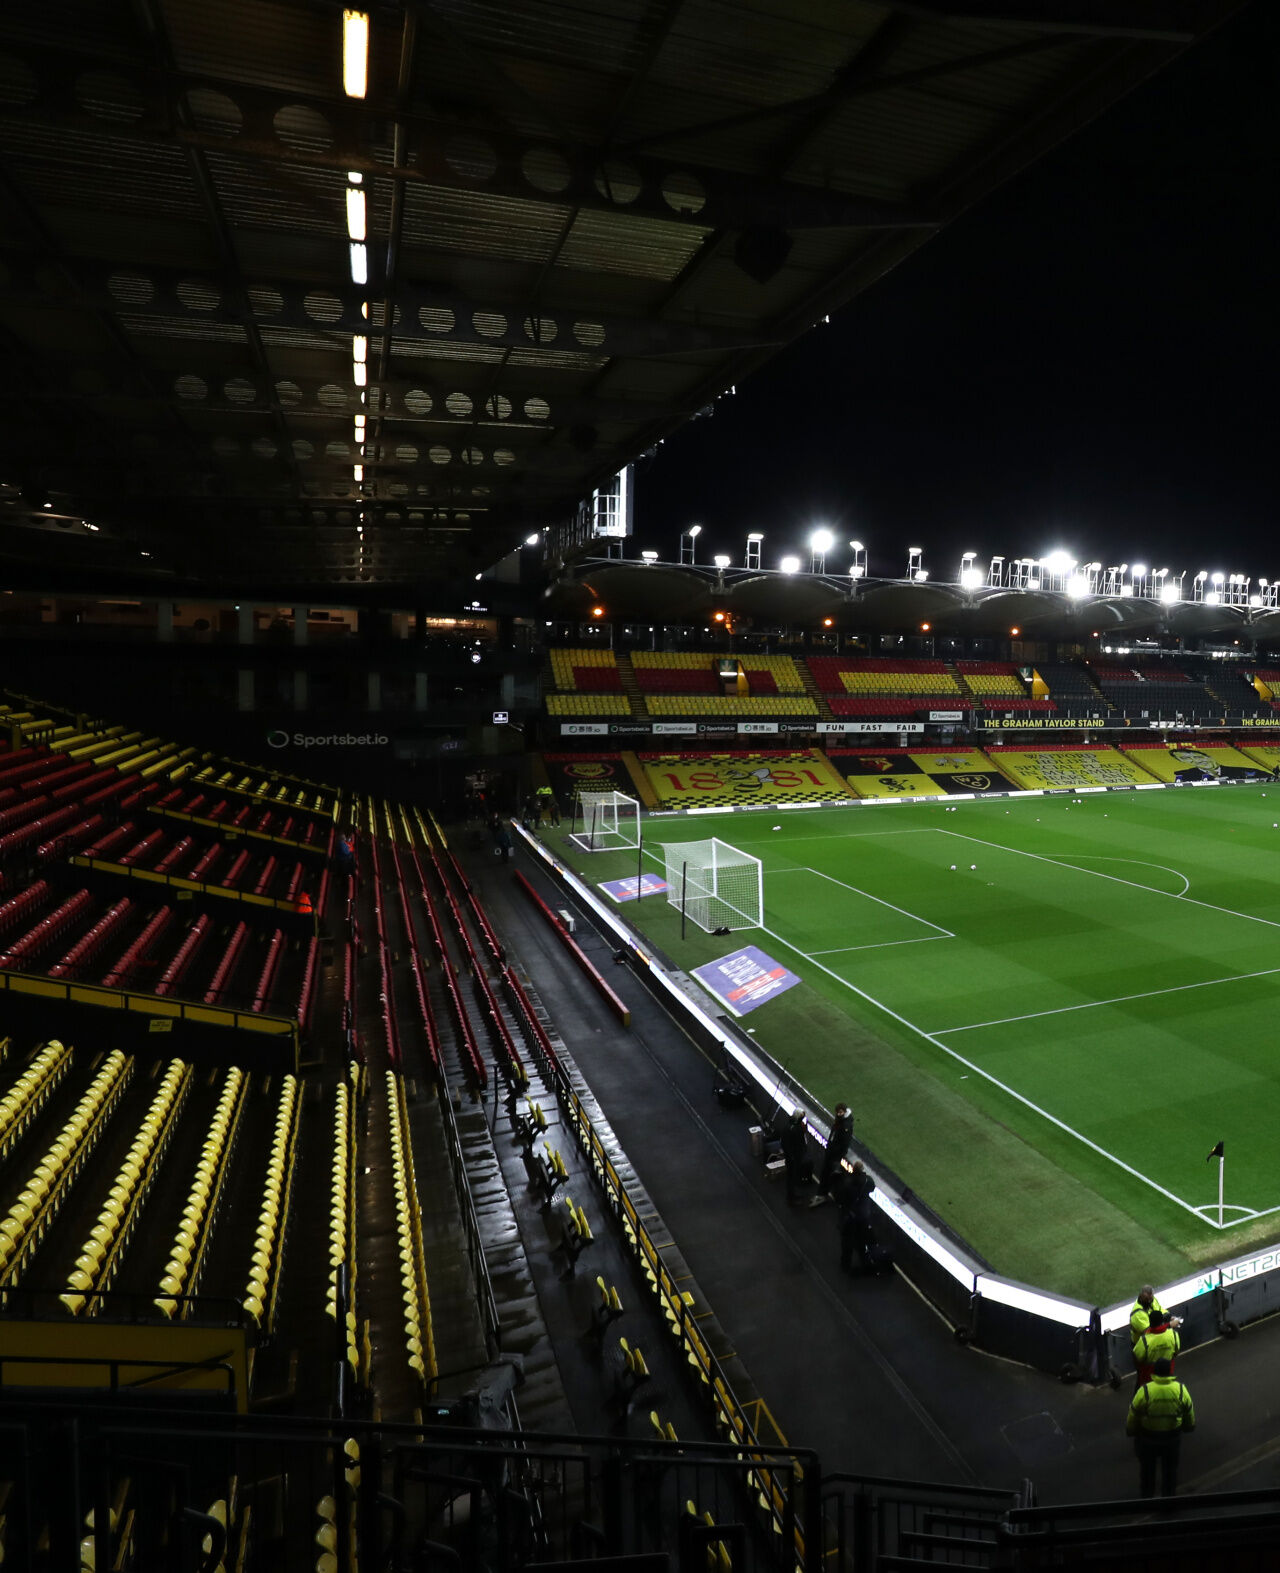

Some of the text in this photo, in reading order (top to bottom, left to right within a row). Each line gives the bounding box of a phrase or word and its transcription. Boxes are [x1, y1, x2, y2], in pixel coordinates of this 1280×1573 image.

[983, 719, 1105, 728] THE GRAHAM TAYLOR STAND
[1242, 718, 1254, 726] THE
[293, 733, 388, 748] Sportsbet.io
